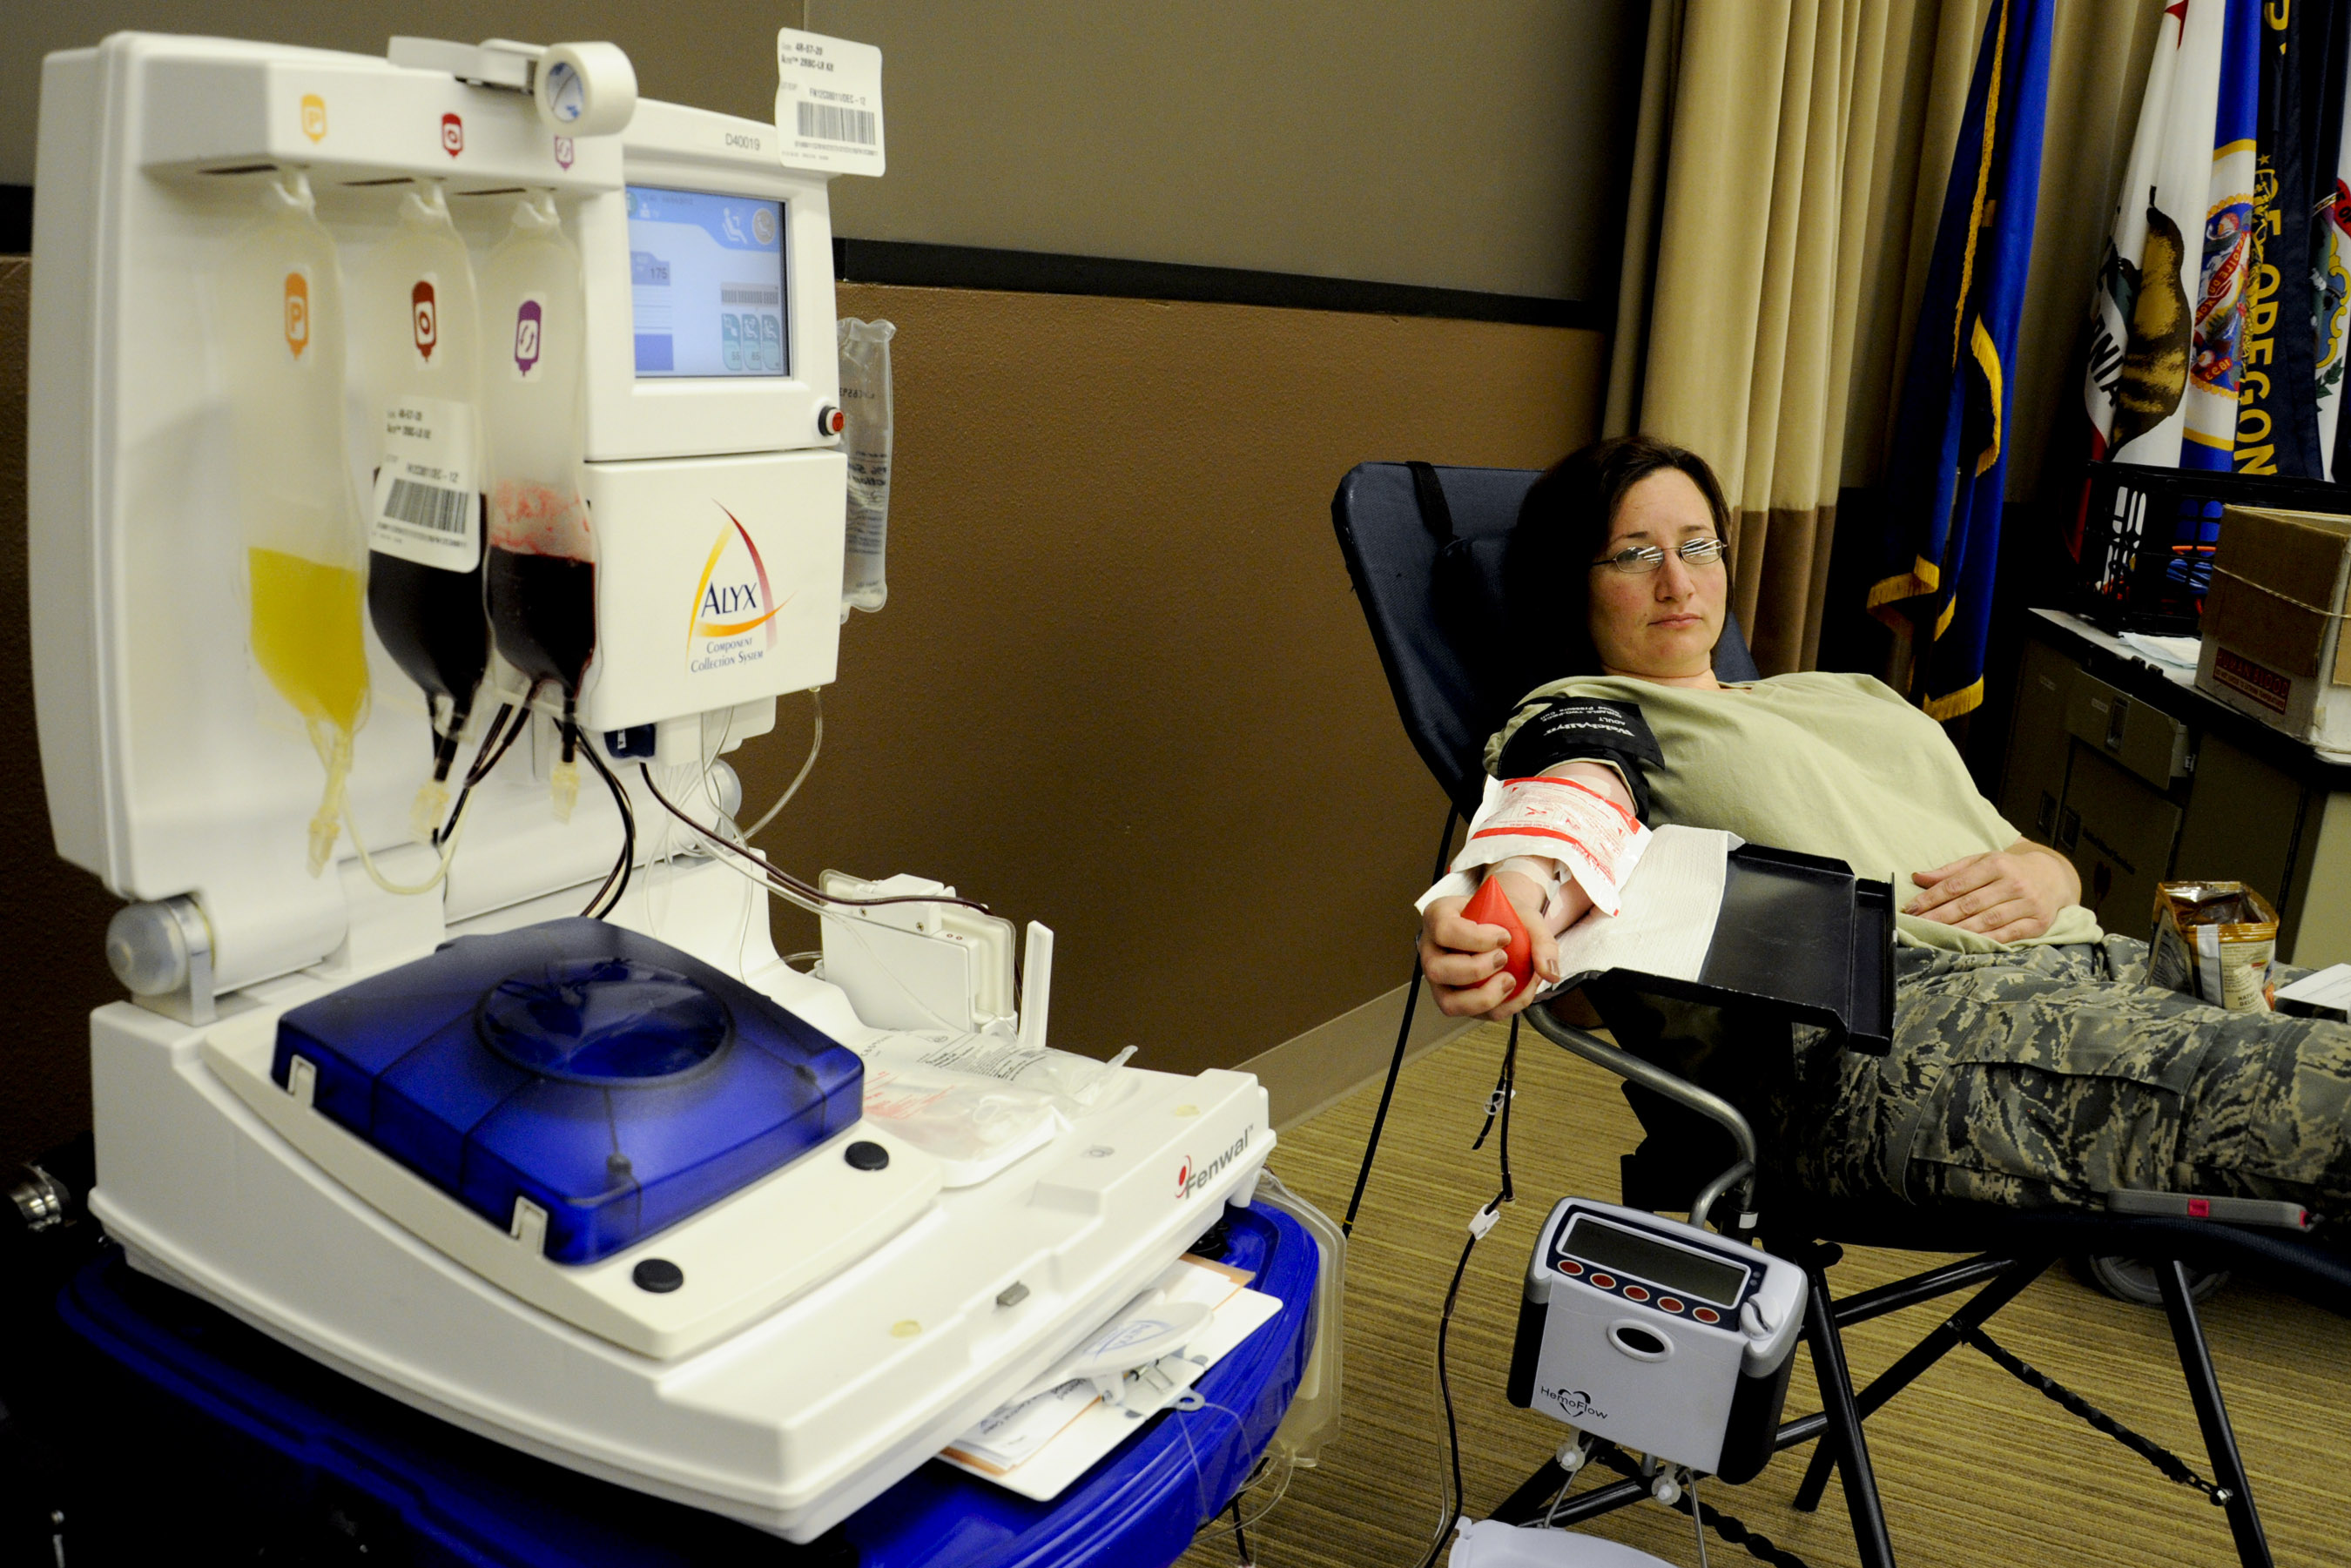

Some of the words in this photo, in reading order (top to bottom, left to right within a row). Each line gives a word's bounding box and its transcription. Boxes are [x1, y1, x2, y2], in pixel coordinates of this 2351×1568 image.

[725, 132, 760, 151] D40019
[2233, 263, 2281, 475] OREGON
[701, 581, 758, 618] ALYX
[1599, 717, 1626, 726] ADULT
[1185, 1128, 1249, 1200] Fenwal
[1540, 1385, 1608, 1419] HemoFlow
